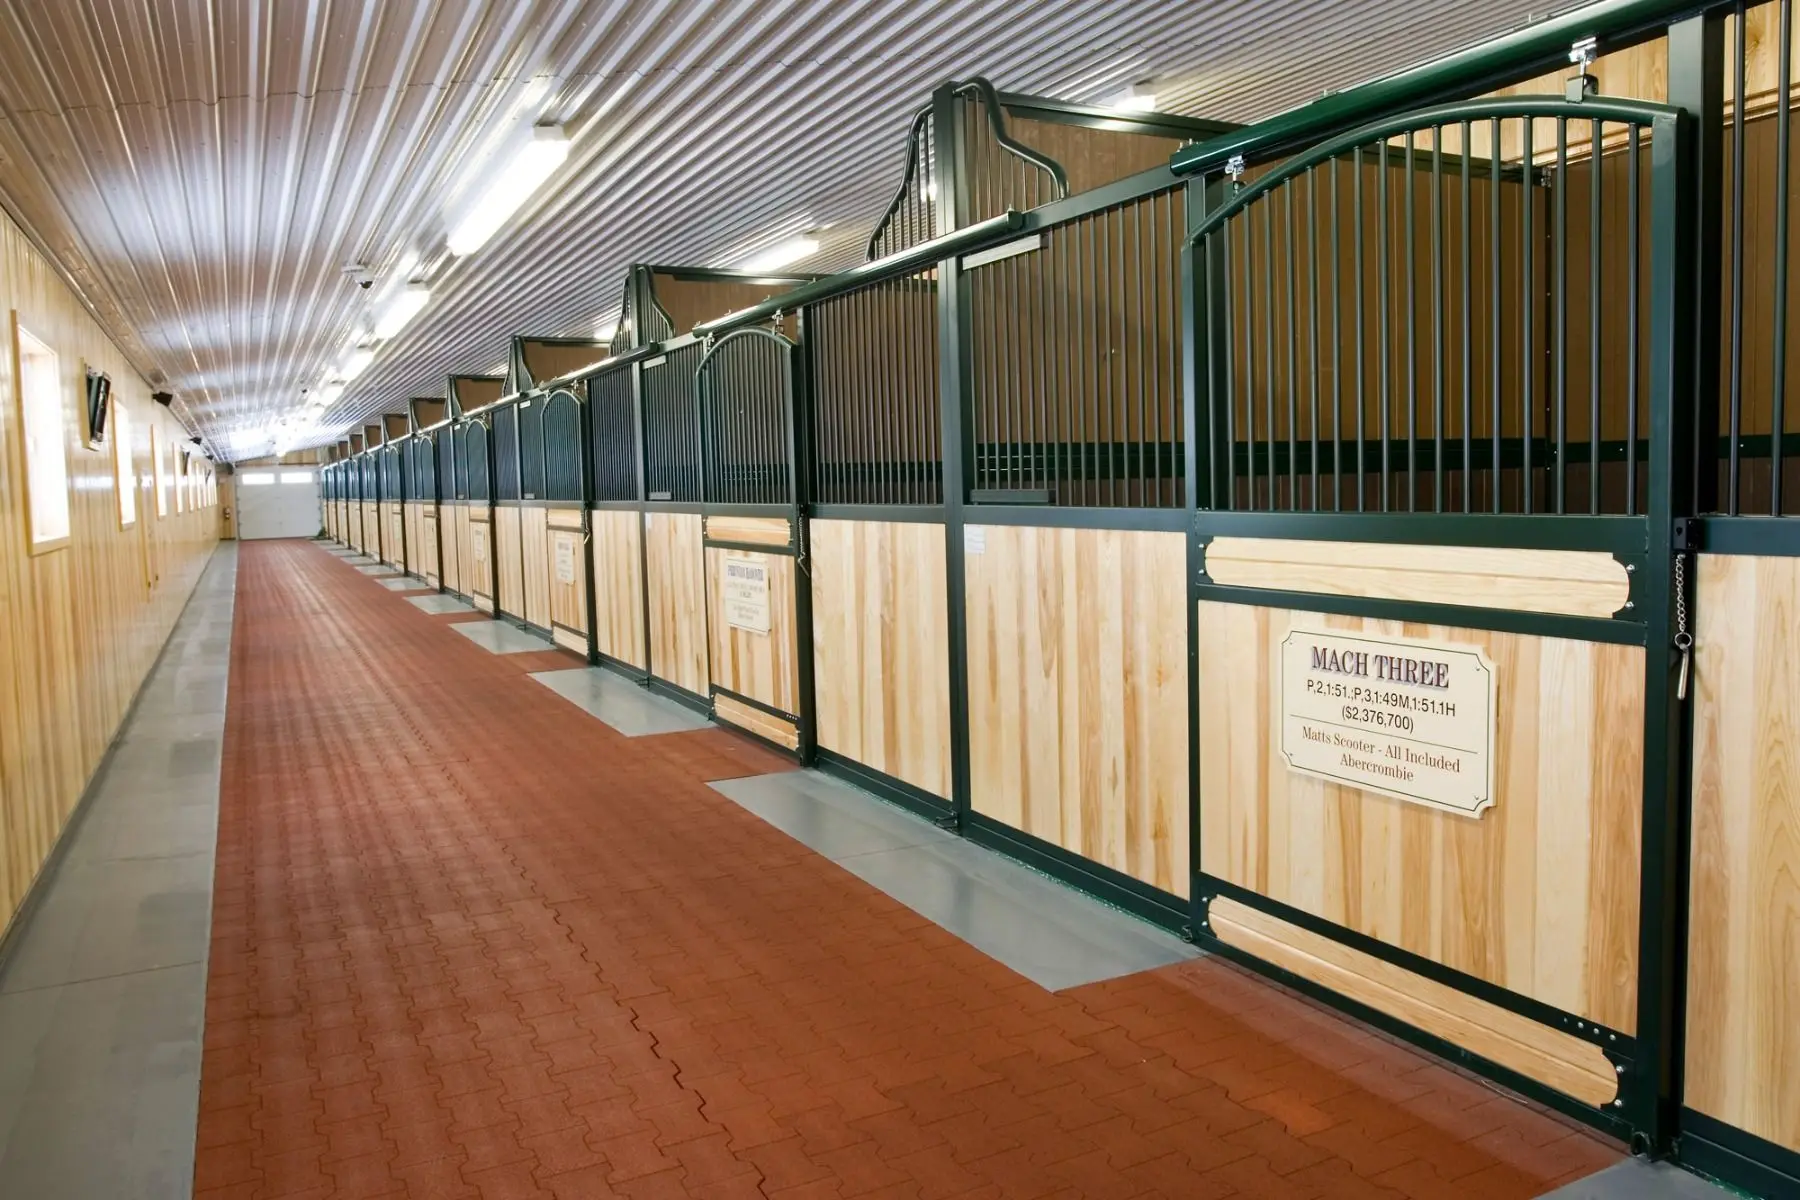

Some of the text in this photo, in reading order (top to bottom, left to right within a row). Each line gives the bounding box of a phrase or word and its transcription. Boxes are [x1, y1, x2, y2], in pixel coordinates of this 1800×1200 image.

[1311, 646, 1450, 690] MACH THREE
[1342, 706, 1414, 734] ($2,376,700)
[1302, 726, 1332, 744] Matts
[1334, 733, 1375, 754] Scooter
[1384, 745, 1401, 760] All
[1405, 748, 1460, 773] Included
[1340, 753, 1414, 781] Abercrombie
